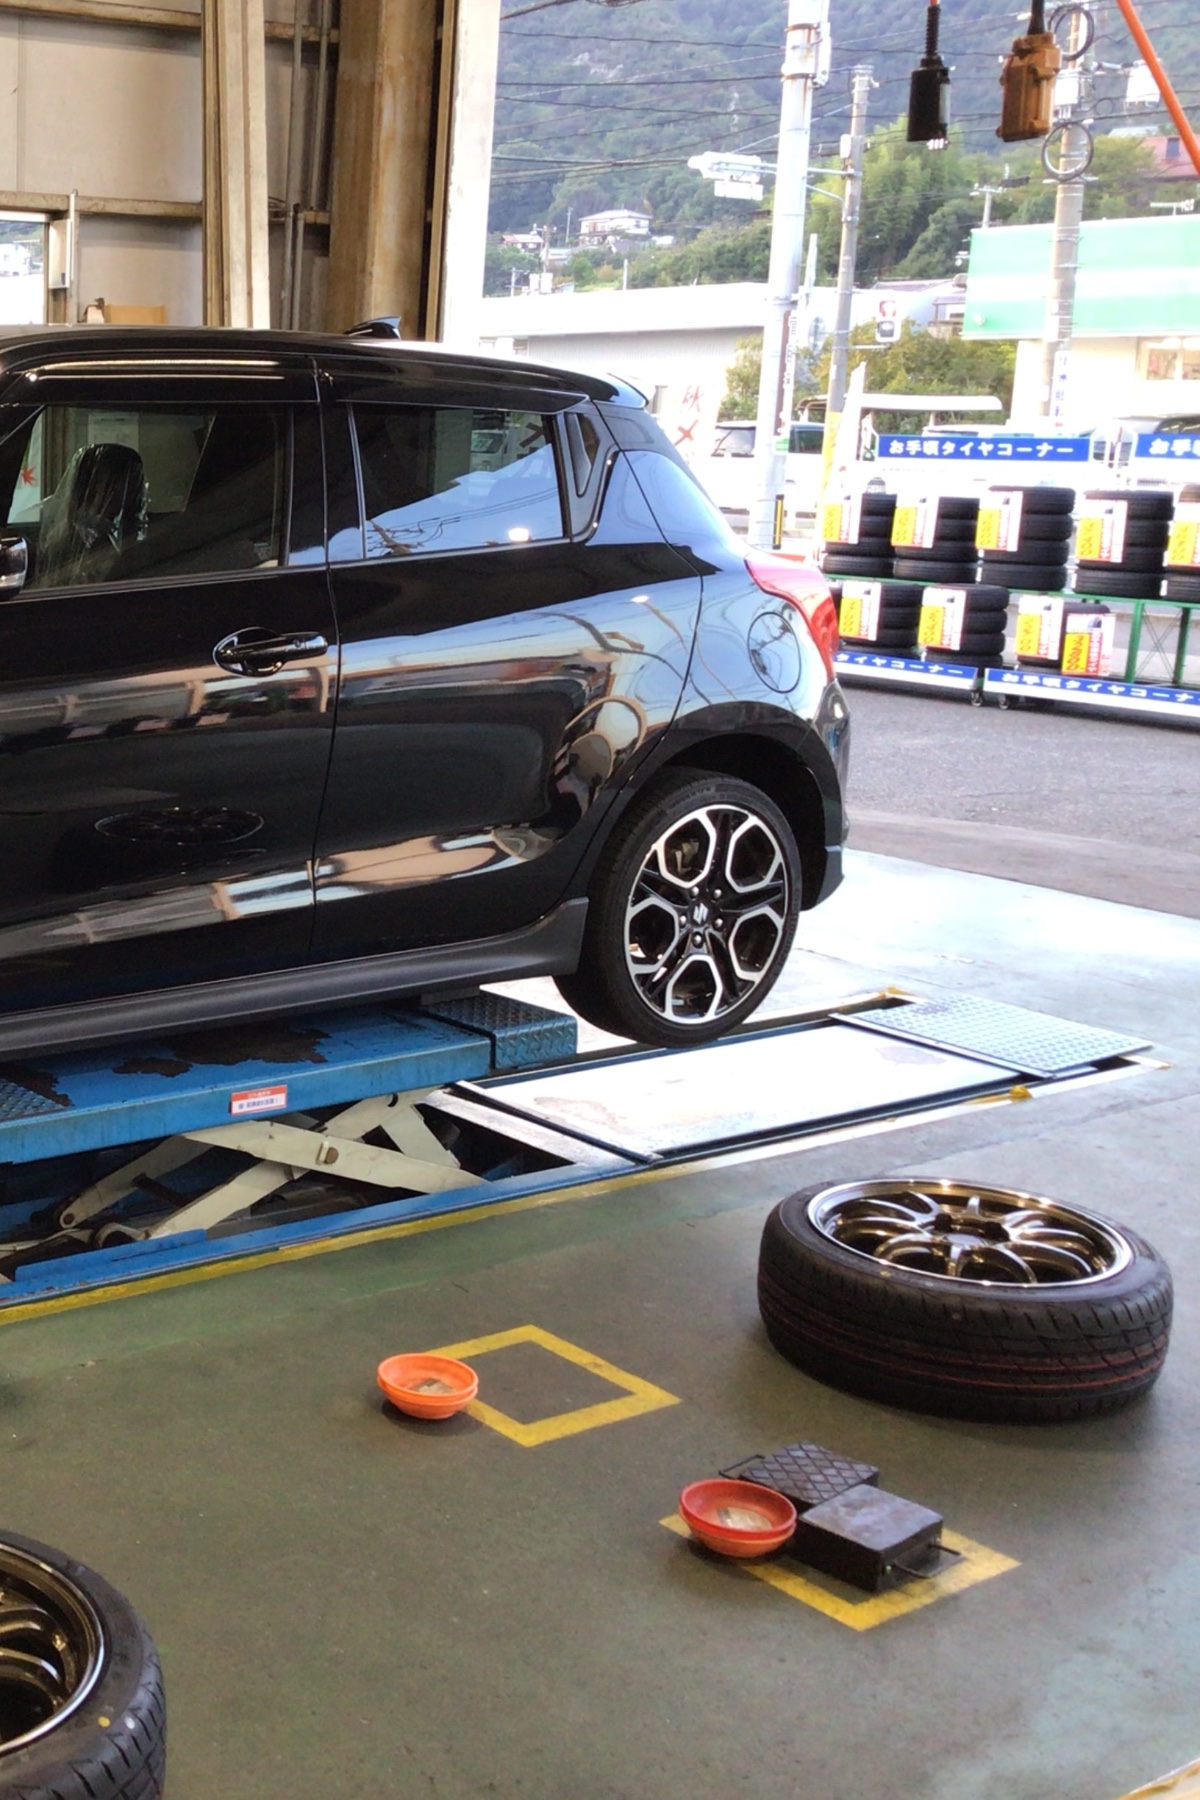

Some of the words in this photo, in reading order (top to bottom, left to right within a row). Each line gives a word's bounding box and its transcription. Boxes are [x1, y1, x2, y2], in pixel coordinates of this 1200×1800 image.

[889, 440, 1074, 458] お手頃タイヤコーナー
[1001, 672, 1200, 702] お手頃タイヤコーナ
